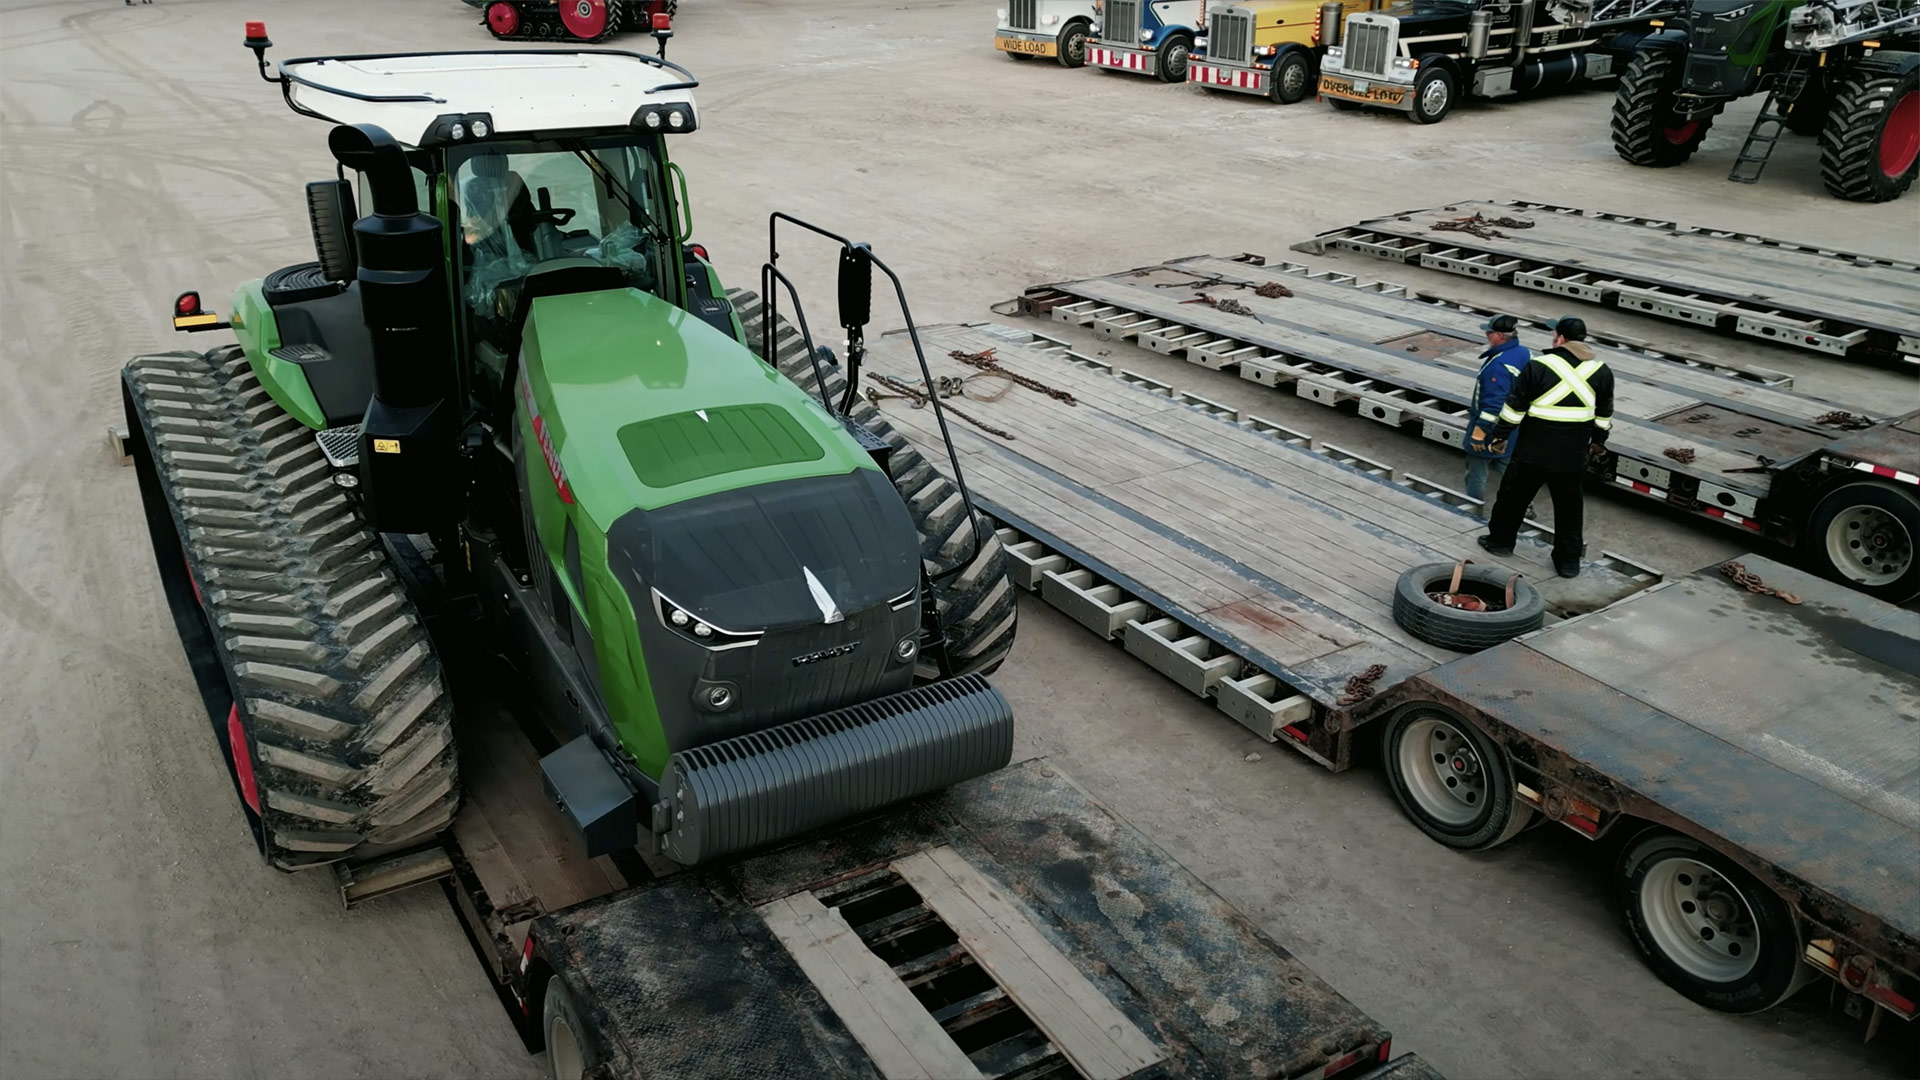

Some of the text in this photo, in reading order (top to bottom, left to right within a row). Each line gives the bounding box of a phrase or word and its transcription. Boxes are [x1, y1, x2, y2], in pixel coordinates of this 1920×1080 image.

[1003, 39, 1046, 54] WIDE LOAD
[539, 418, 568, 490] FENDT
